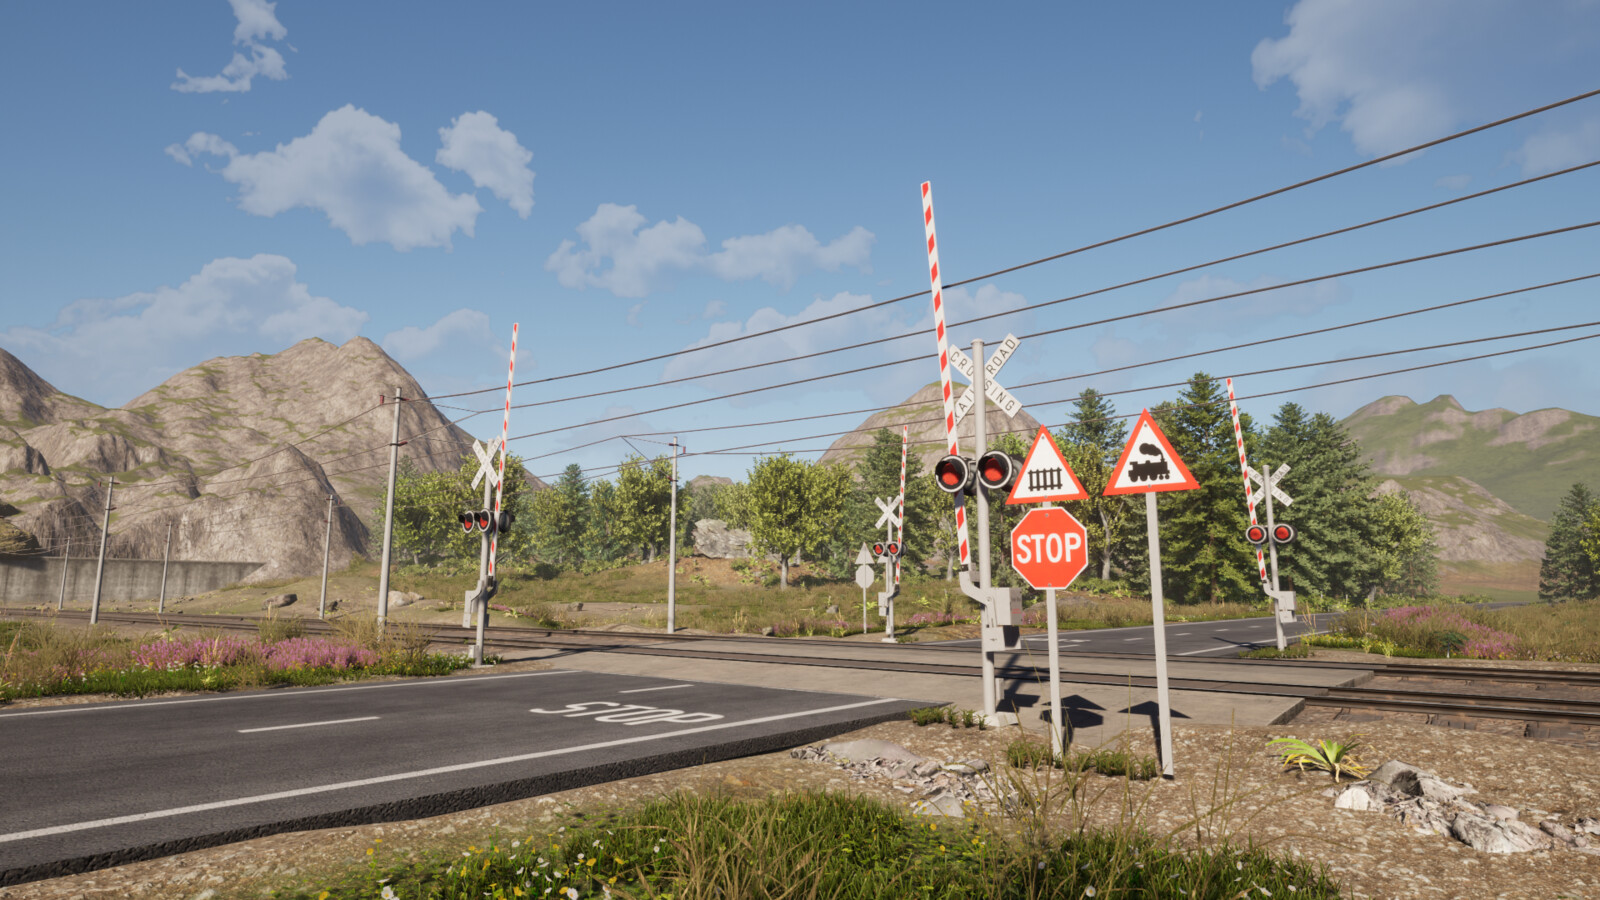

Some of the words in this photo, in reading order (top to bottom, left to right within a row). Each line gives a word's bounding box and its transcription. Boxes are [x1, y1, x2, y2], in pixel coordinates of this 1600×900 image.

[985, 338, 1016, 375] ROAD
[950, 351, 1015, 411] CROSING
[1016, 532, 1082, 564] STOP
[528, 701, 725, 726] STOP
